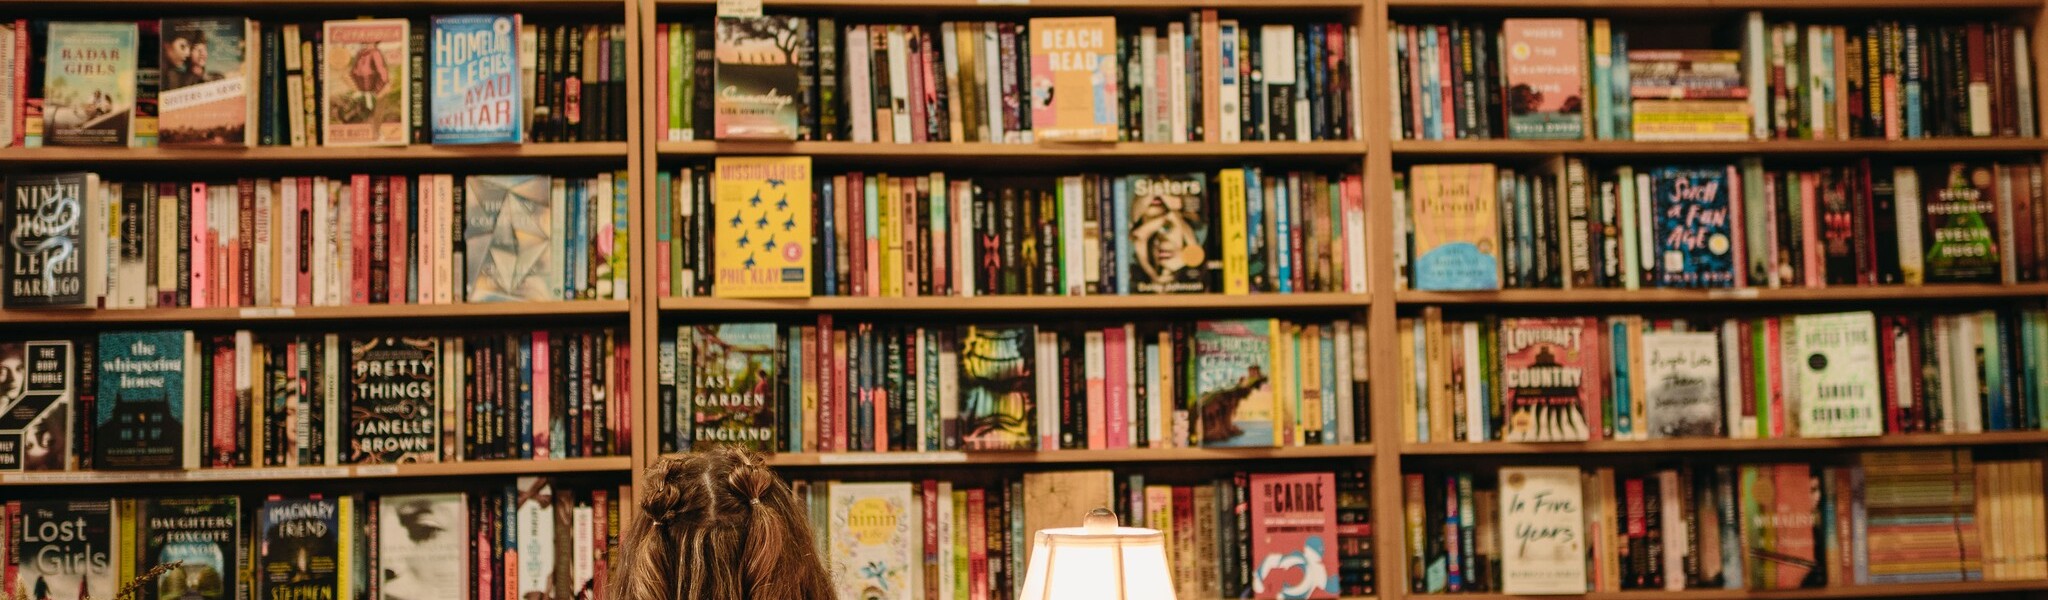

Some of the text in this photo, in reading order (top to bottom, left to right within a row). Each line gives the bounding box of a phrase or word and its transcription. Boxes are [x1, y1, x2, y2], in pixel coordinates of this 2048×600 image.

[1042, 28, 1103, 49] BEACH
[1522, 28, 1564, 39] WHERE
[62, 49, 120, 61] RADAR
[435, 30, 510, 71] HOMELAND
[1535, 46, 1556, 57] THE
[64, 63, 116, 75] GIRLS
[1048, 52, 1098, 71] READ
[435, 54, 510, 101] ELEGIES
[1512, 65, 1578, 76] CRAWDADS
[164, 91, 202, 106] SISTERS
[465, 74, 511, 113] AYAD
[437, 101, 510, 132] AKHTAR
[720, 164, 806, 181] MISSIONARIES
[1134, 178, 1201, 196] Sisters
[1437, 183, 1469, 199] Jodi
[1939, 187, 1980, 201] SEVEN
[15, 184, 80, 210] NINTH
[1421, 197, 1488, 214] Picoult
[1927, 200, 1994, 214] HUSBANDS
[15, 212, 80, 239] HOUSE
[1935, 227, 1990, 242] EVELYN
[1942, 243, 1985, 257] HUGO
[14, 251, 80, 276] LEIGH
[720, 267, 779, 284] PHIL KLAY
[13, 276, 80, 297] BARDUGO
[1165, 281, 1204, 292] Johnson
[131, 340, 156, 356] the
[1506, 326, 1583, 356] LOVECRAFT
[39, 347, 55, 359] THE
[36, 359, 58, 371] BODY
[103, 356, 182, 375] whispering
[356, 359, 433, 377] PRETTY
[31, 372, 62, 384] DOUBLE
[120, 374, 165, 389] house
[695, 370, 736, 389] LAST
[1508, 367, 1582, 388] COUNTRY
[357, 381, 432, 399] THINGS
[695, 392, 765, 408] GARDEN
[356, 418, 433, 436] JANELLE
[820, 403, 832, 438] ARTIST
[695, 426, 772, 441] ENGLAND
[361, 437, 428, 452] BROWN
[1274, 476, 1324, 513] CARRÉ
[1508, 487, 1575, 515] In Five
[37, 508, 53, 518] The
[268, 501, 334, 523] IMAGINARY
[23, 515, 87, 543] Lost
[151, 517, 233, 530] DAUGHTERS
[277, 519, 328, 539] FRIEND
[165, 530, 230, 543] FOXCOTE
[1515, 522, 1575, 558] Years
[37, 543, 107, 577] Girls
